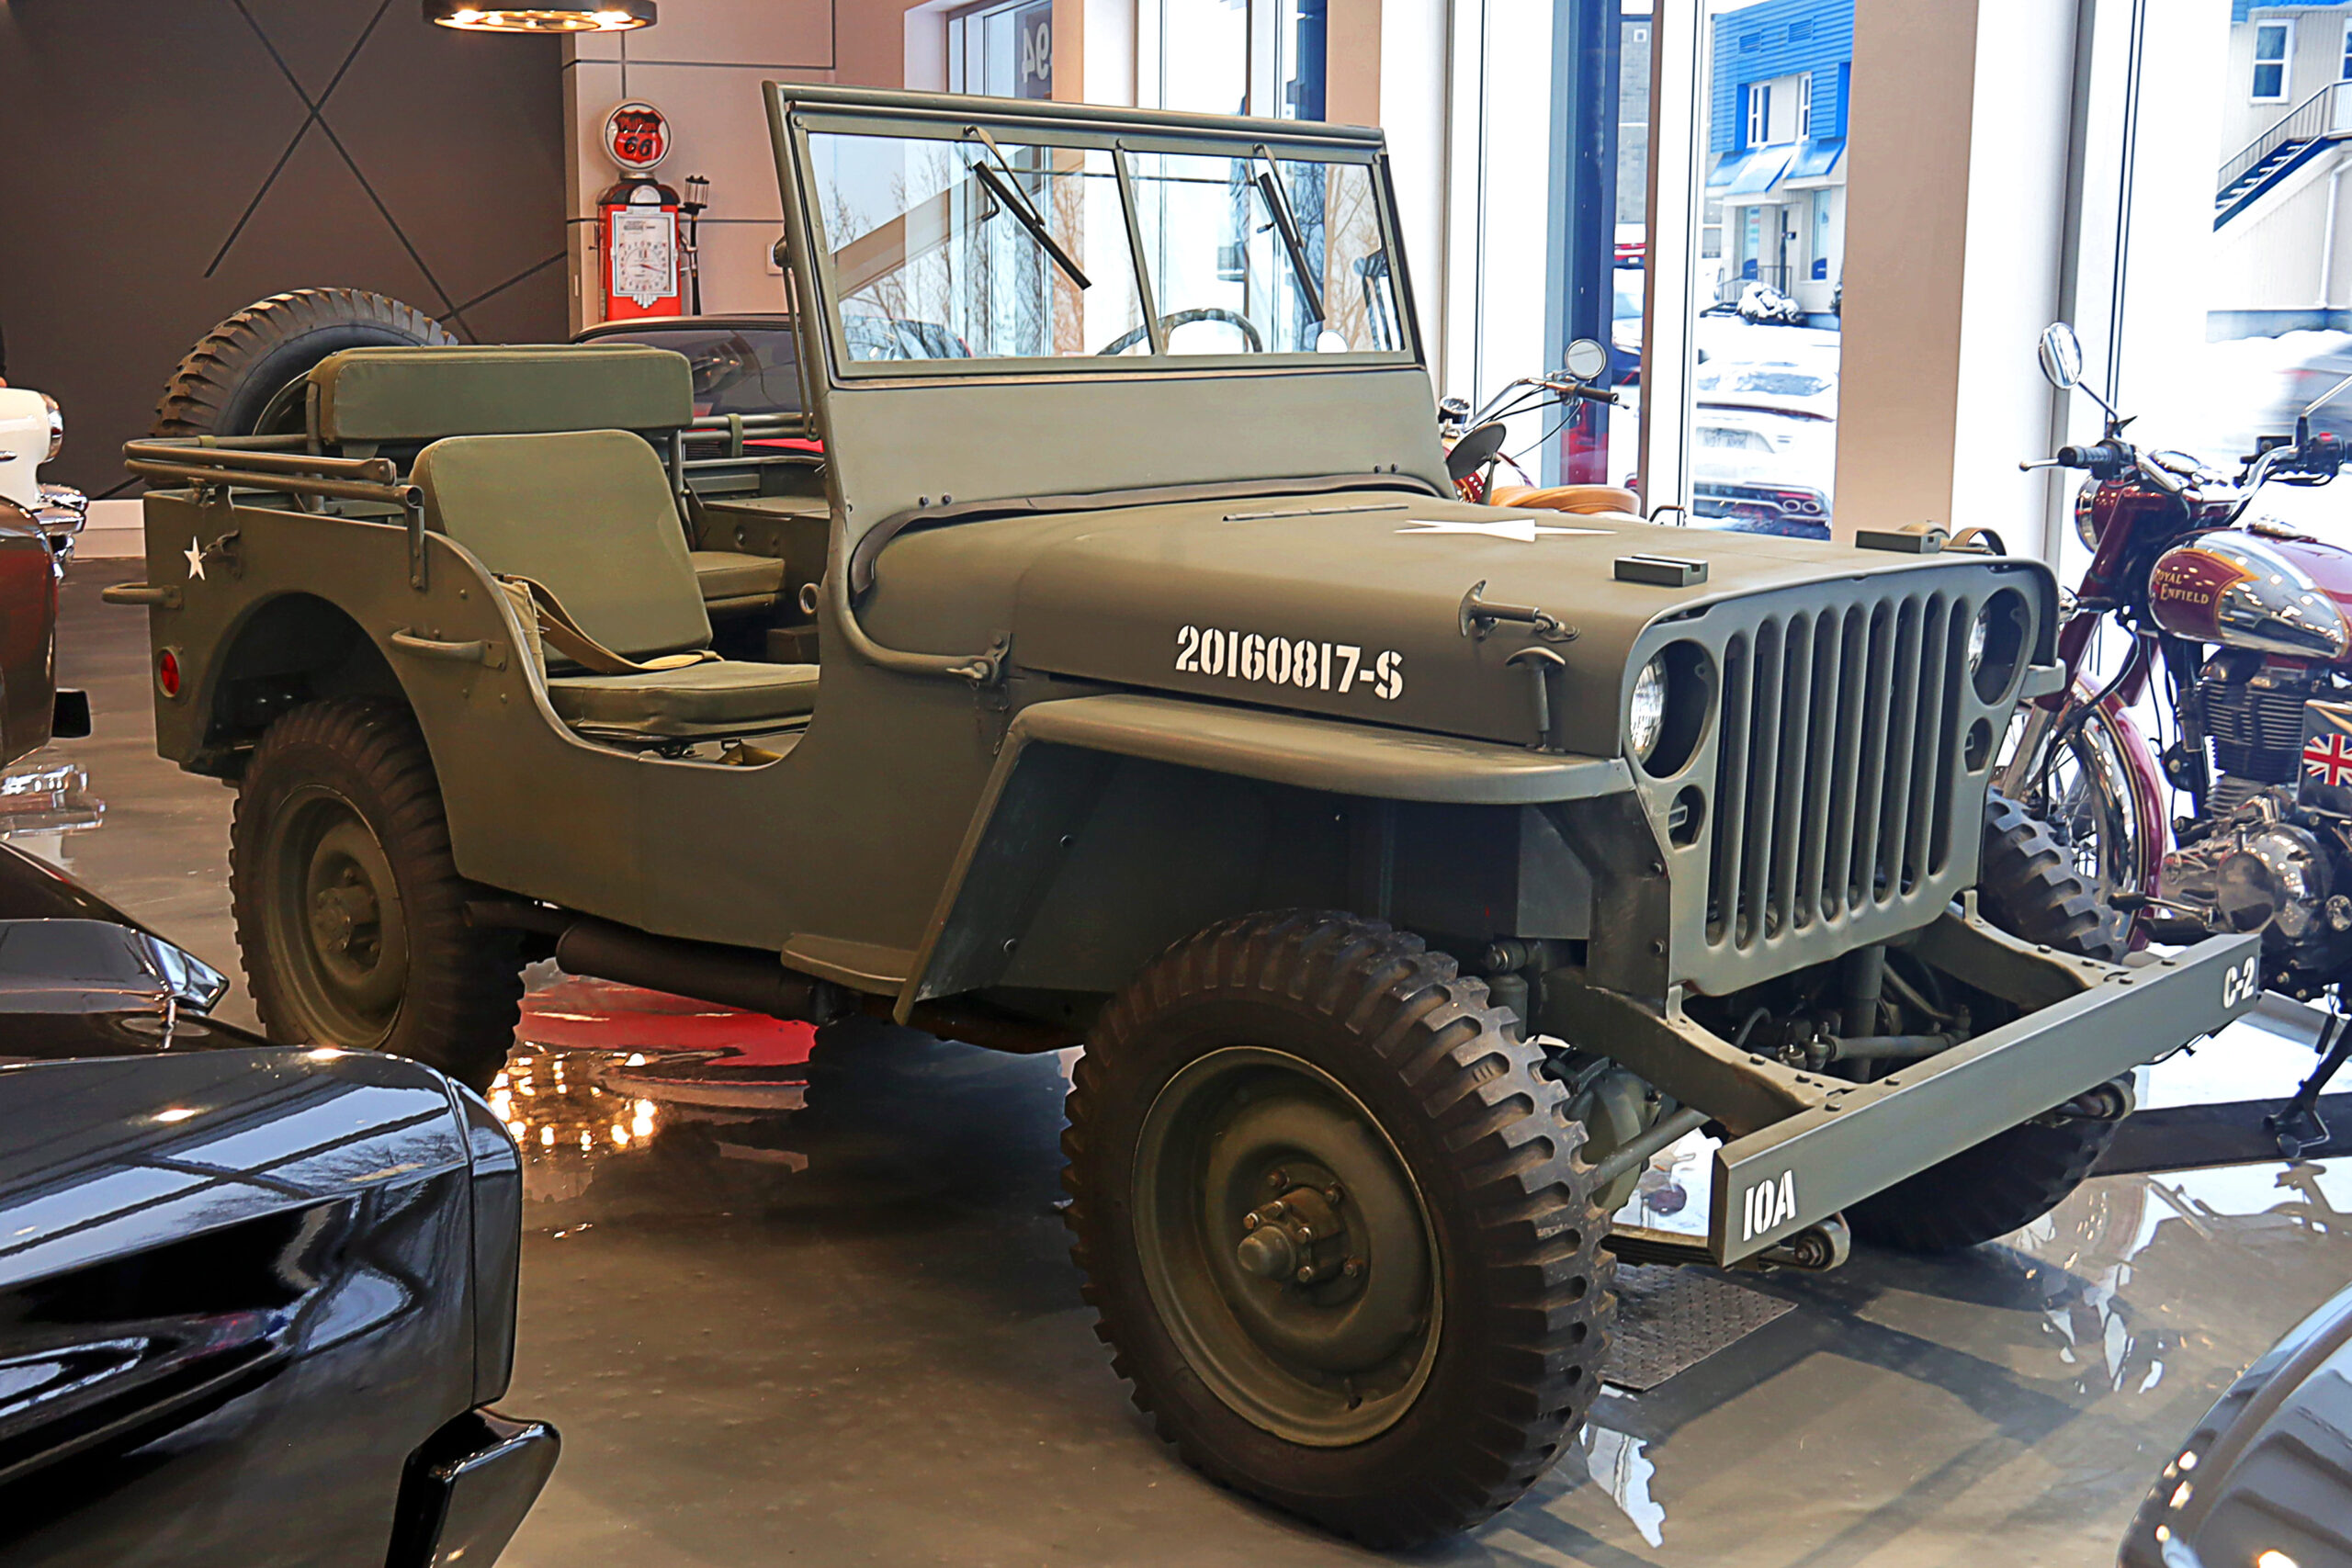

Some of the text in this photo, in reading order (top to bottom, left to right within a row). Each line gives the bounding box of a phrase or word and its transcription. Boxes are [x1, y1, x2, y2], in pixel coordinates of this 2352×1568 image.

[624, 136, 653, 157] 66
[2160, 582, 2210, 604] ENFIELD
[1175, 625, 1403, 700] 20160817-S
[2223, 956, 2255, 1009] C-2
